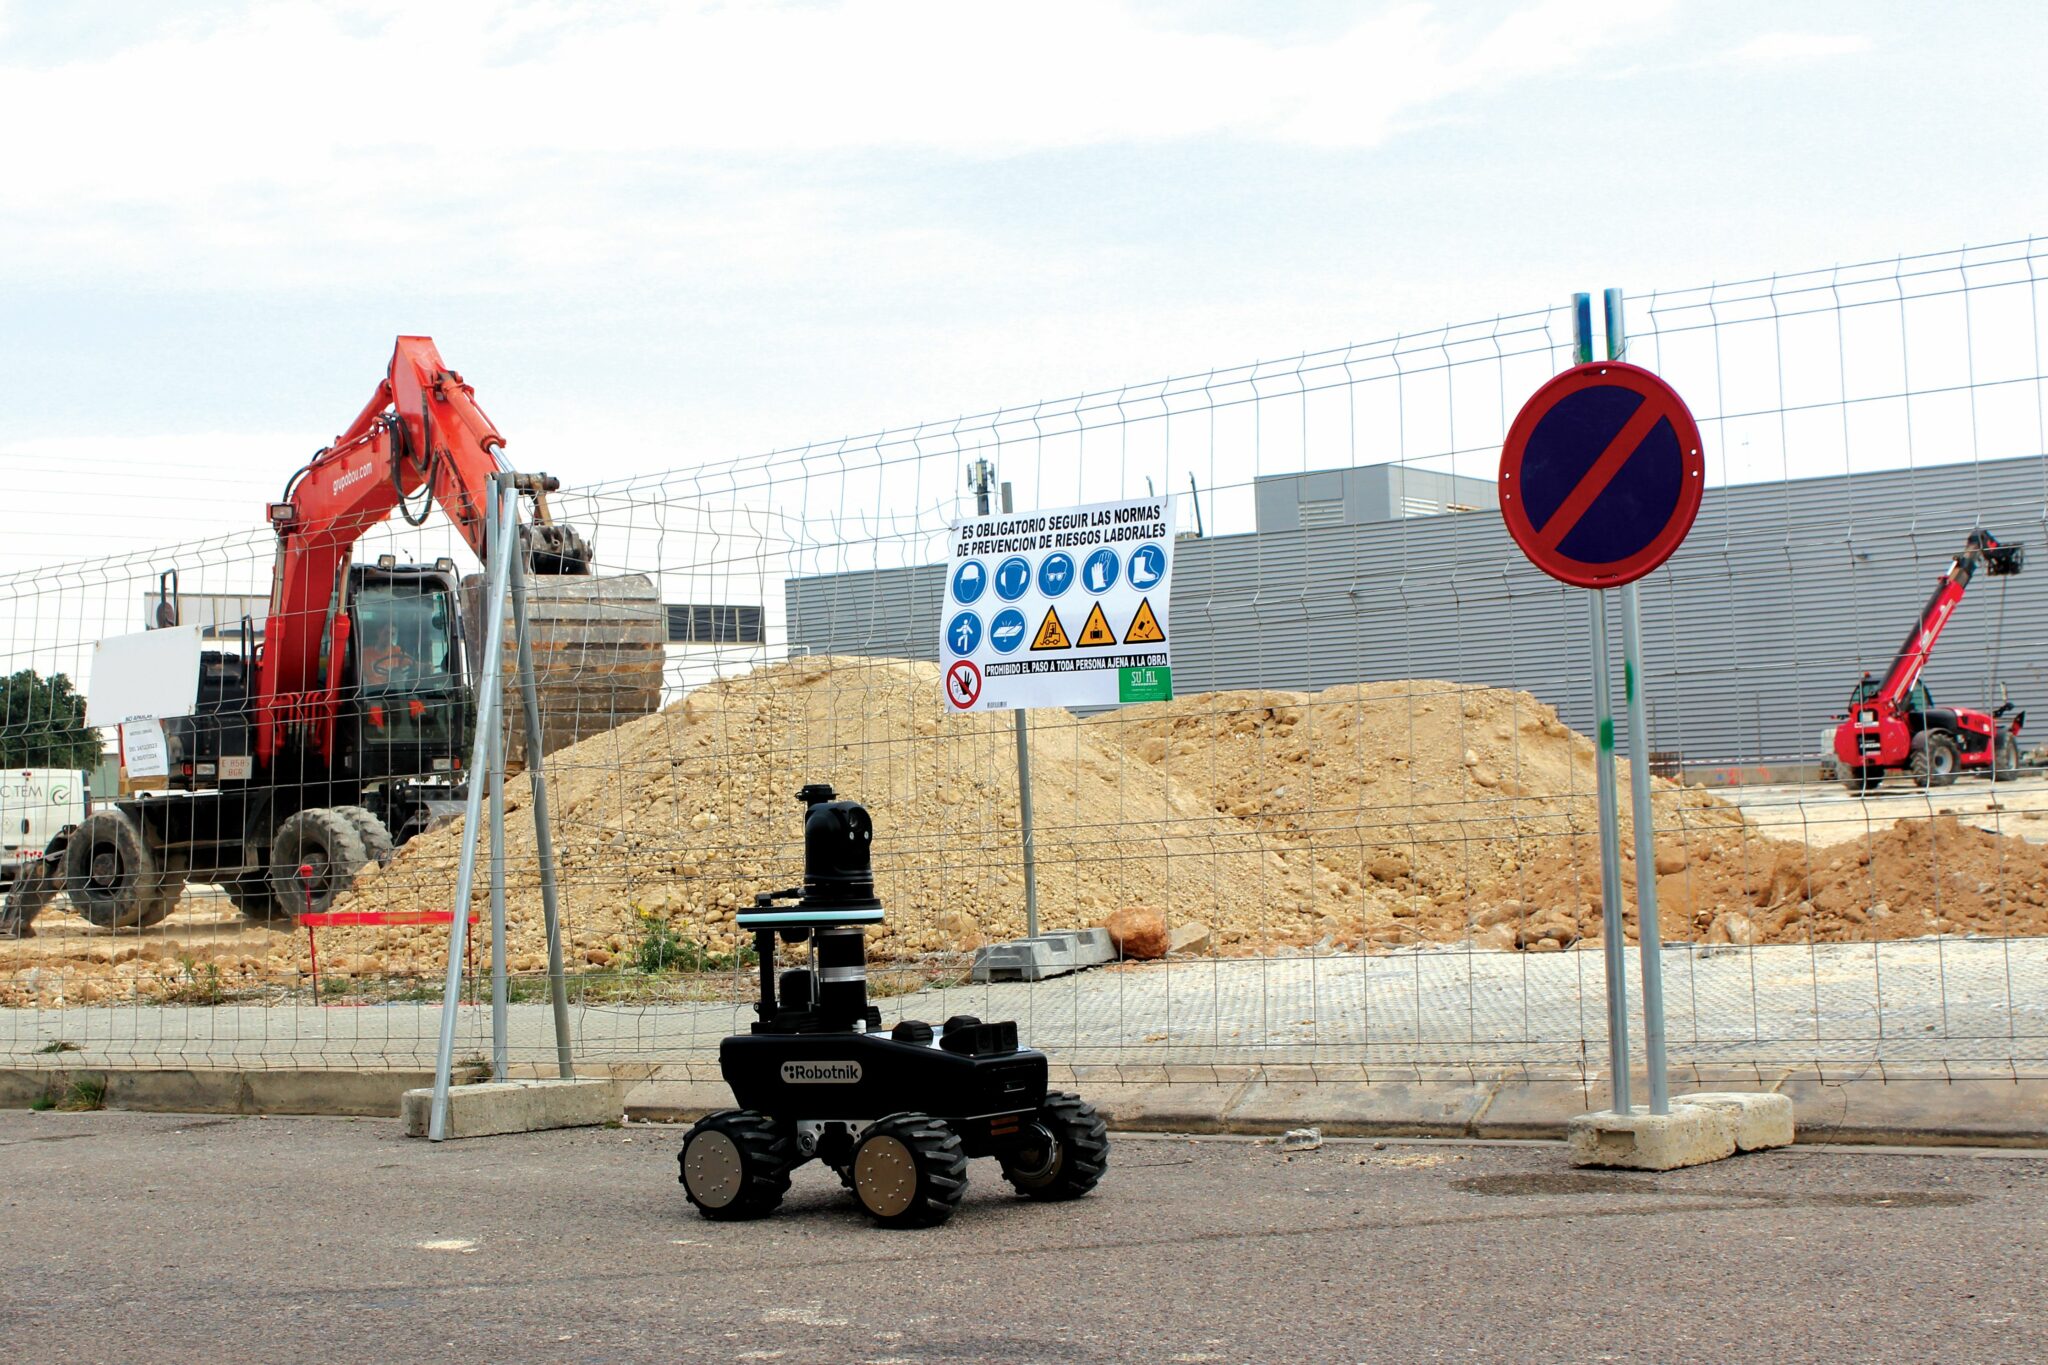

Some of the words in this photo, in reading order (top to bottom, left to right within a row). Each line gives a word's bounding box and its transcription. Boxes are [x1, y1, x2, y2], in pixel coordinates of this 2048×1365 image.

[962, 526, 974, 539] ES
[976, 517, 1045, 538] OBLIGATORIO
[1050, 514, 1088, 530] SEGUIR
[1091, 510, 1111, 526] LAS
[1114, 505, 1160, 524] NORMAS
[957, 543, 969, 557] DE
[971, 536, 1036, 556] PREVENCION
[1039, 534, 1052, 548] DE
[1055, 530, 1100, 547] RIESGOS
[1104, 523, 1166, 542] LABORALES
[986, 663, 1021, 676] PROHIBIDO
[1022, 662, 1031, 673] EL
[1032, 661, 1049, 672] PASO
[1050, 661, 1056, 671] A
[1056, 660, 1074, 670] TODA
[1076, 658, 1106, 670] PERSONA
[1107, 656, 1129, 668] AJENA
[1130, 656, 1136, 666] A
[1137, 656, 1146, 666] LA
[1147, 654, 1167, 666] OBRA
[796, 1065, 858, 1079] Robotnik
